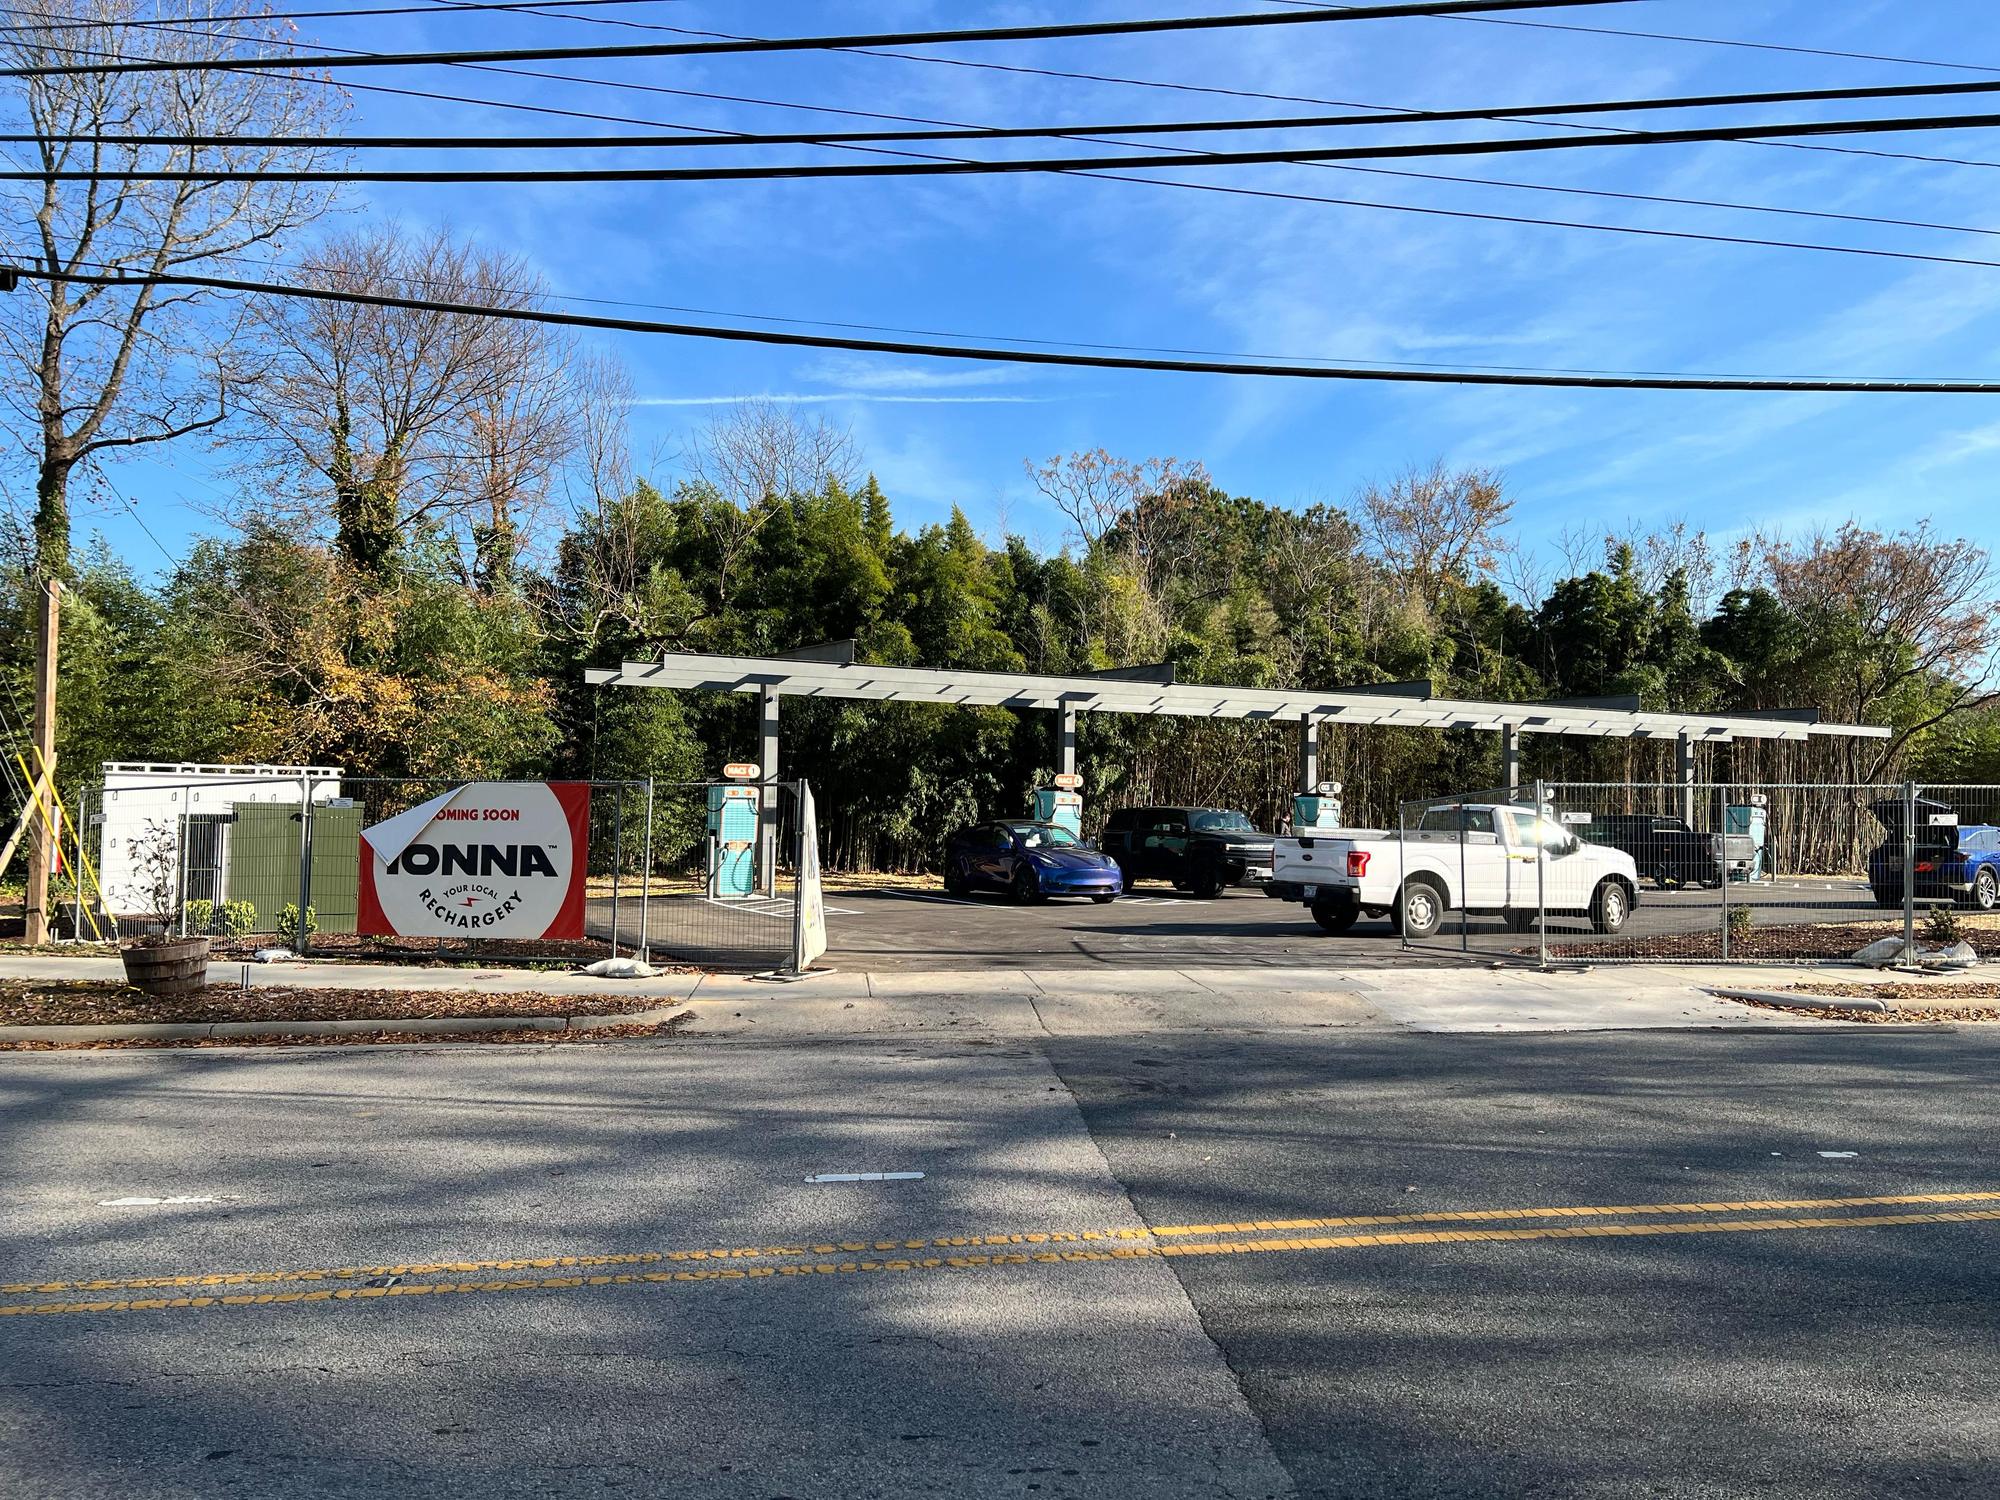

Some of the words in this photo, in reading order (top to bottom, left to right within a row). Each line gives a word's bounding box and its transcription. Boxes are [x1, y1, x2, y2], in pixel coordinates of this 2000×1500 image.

[433, 809, 479, 821] OMING
[482, 809, 520, 821] SOON
[442, 884, 469, 899] YOUR
[471, 884, 498, 900] LOCAL
[418, 888, 523, 929] RECHARGERY
